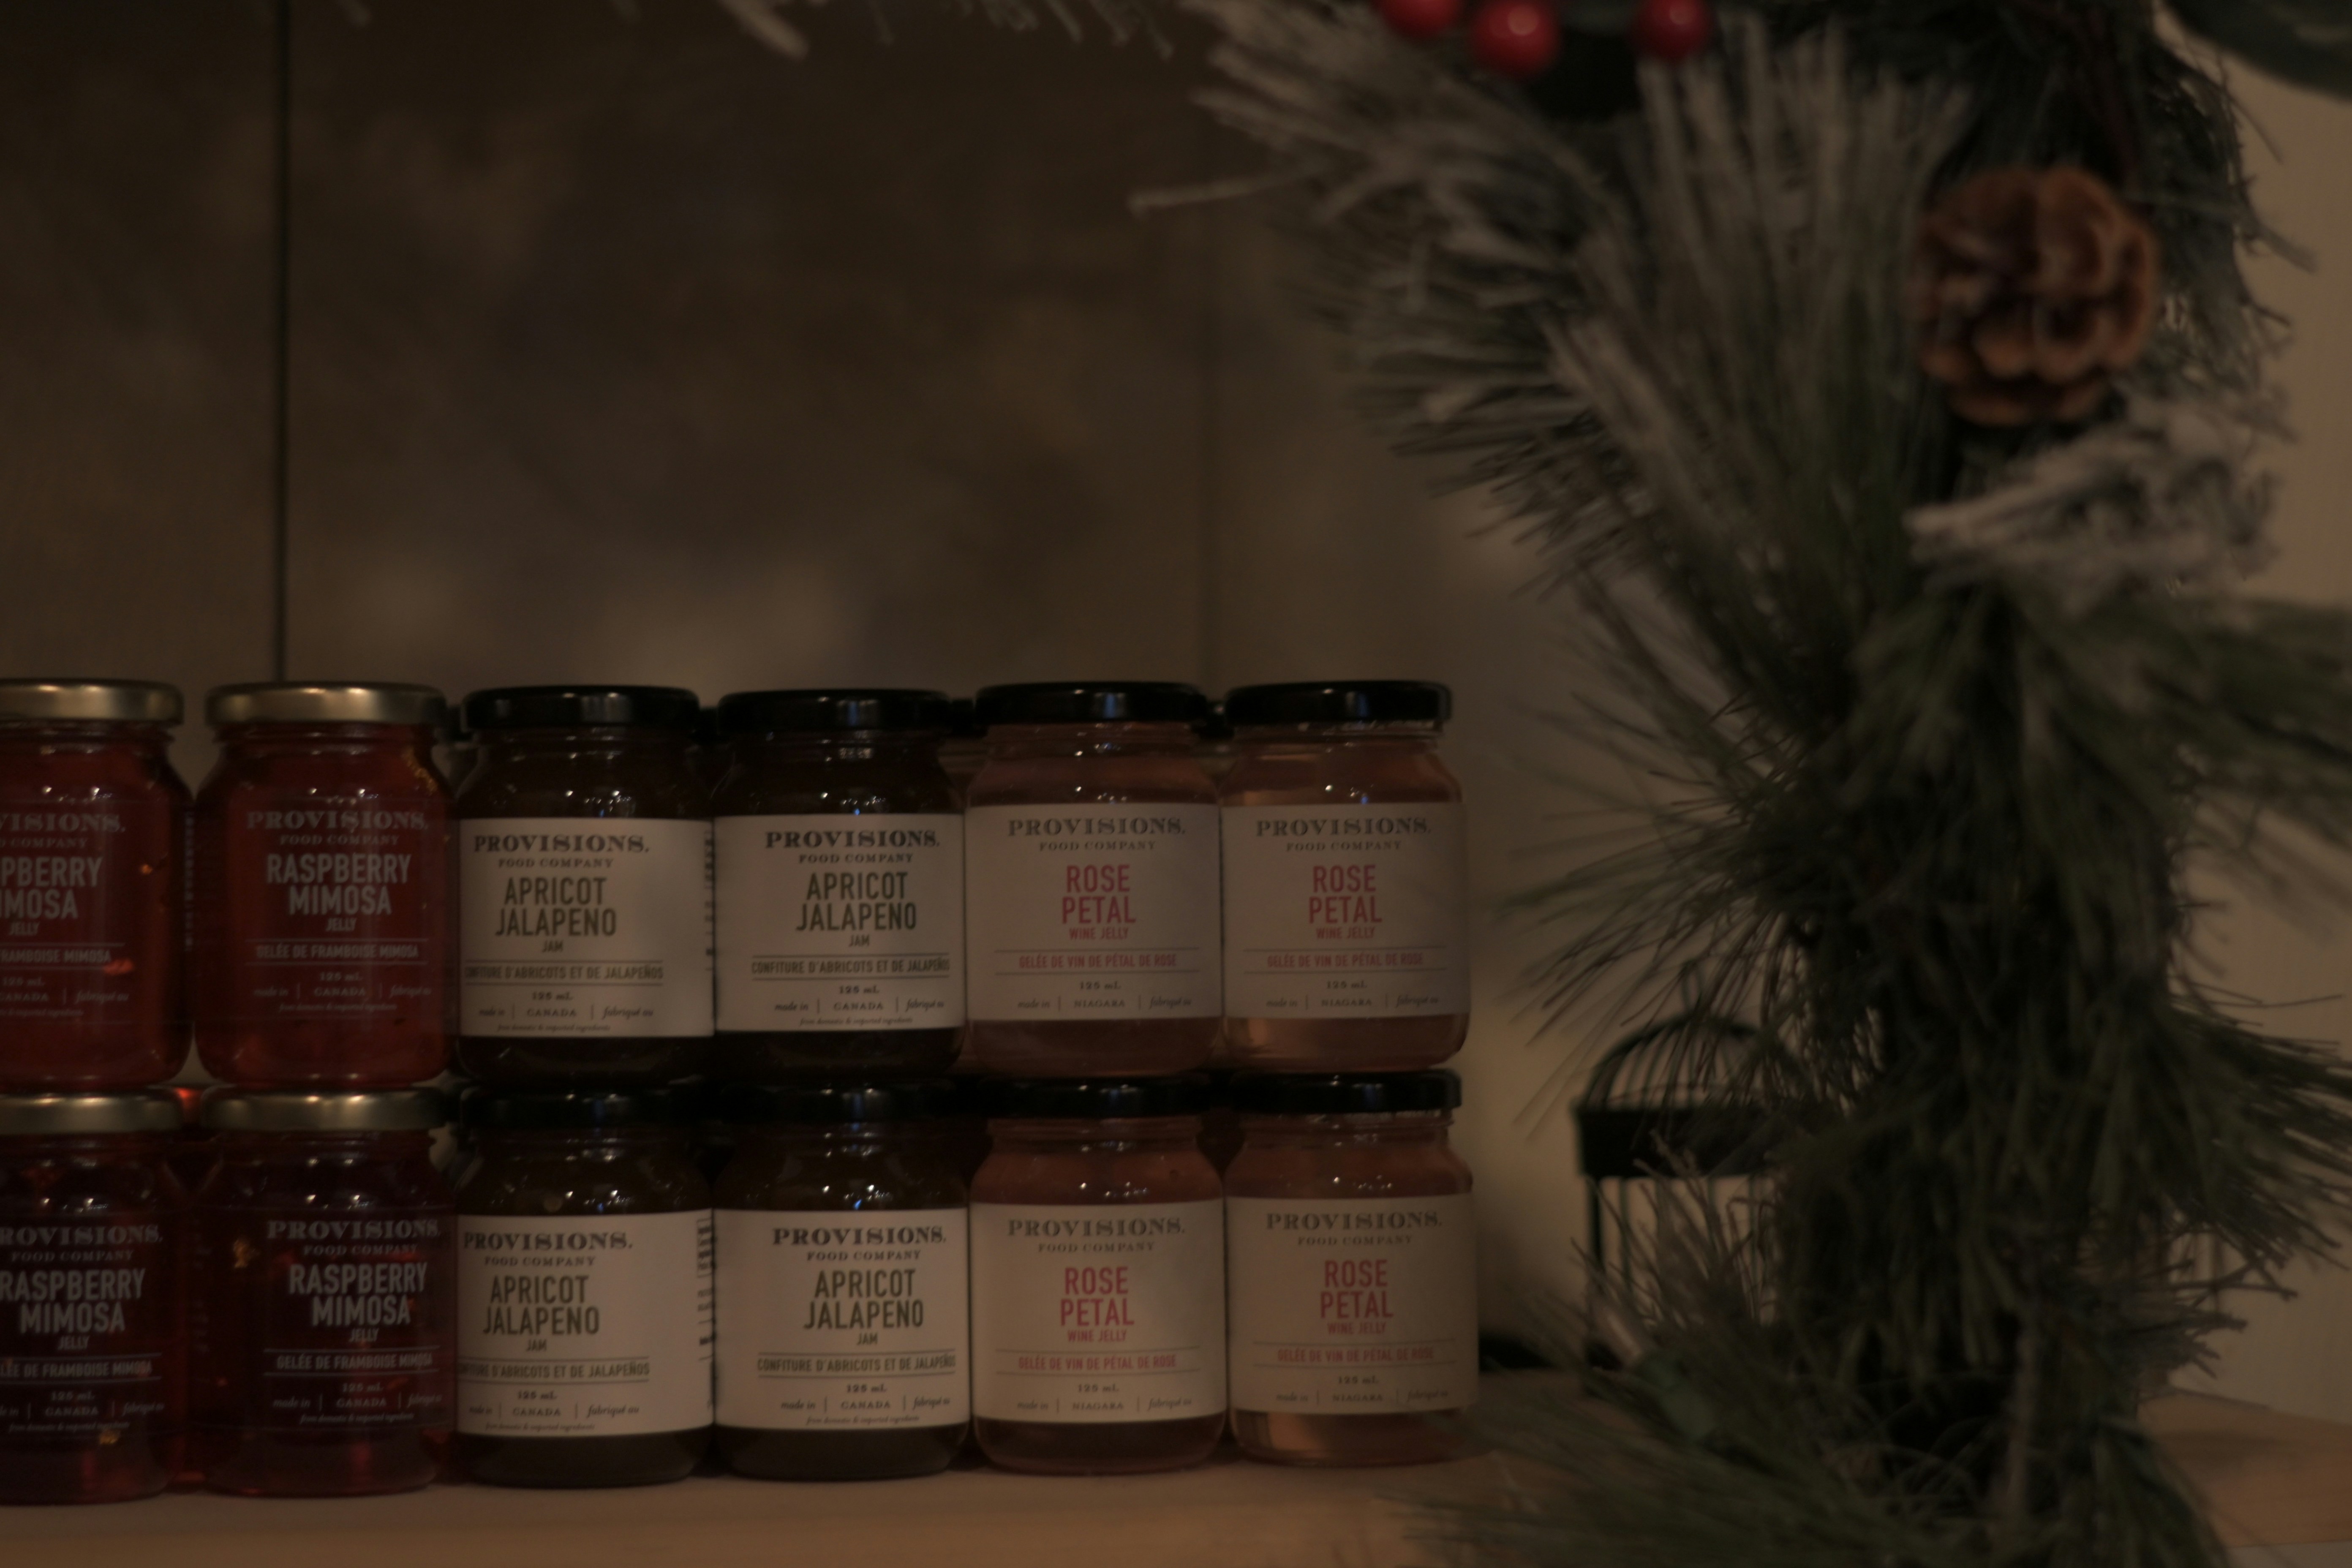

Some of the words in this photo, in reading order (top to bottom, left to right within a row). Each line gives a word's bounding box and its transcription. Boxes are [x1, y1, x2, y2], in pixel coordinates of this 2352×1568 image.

[280, 835, 322, 845] FOOD
[327, 834, 400, 845] COMPANY
[1040, 841, 1079, 852] FOOD
[1085, 841, 1155, 851] COMPANY
[1287, 842, 1325, 852] FOOD
[1330, 841, 1402, 850] COMPANY
[498, 859, 534, 868] FOOD
[540, 859, 613, 868] COMPANY
[799, 855, 839, 863] FOOD
[845, 854, 914, 863] COMPANY
[267, 853, 411, 884] RASPBERRY
[806, 872, 908, 900] APRICOT
[1066, 865, 1130, 893] ROSE
[1313, 865, 1376, 893] ROSE
[504, 877, 606, 905] APRICOT
[289, 885, 392, 915] MIMOSA
[796, 903, 917, 931] JALAPENO
[1062, 896, 1135, 924] PETAL
[1309, 896, 1382, 924] PETAL
[9, 922, 40, 936] JELLY
[326, 918, 357, 931] JELLY
[495, 909, 617, 936] JALAPENO
[1069, 928, 1096, 940] WINE
[1100, 928, 1128, 940] JELLY
[1316, 927, 1342, 939] WINE
[1347, 927, 1375, 938] JELLY
[542, 941, 563, 952] JAM
[849, 935, 870, 947] JAM
[293, 945, 308, 958] DE
[311, 945, 376, 958] FRAMBOISE
[752, 961, 804, 974] CONFITURE
[877, 960, 888, 972] ET
[892, 959, 904, 972] DE
[1019, 954, 1047, 968] GELÉE
[1051, 956, 1063, 968] DE
[1067, 956, 1085, 967] VIN
[1089, 955, 1102, 967] DE
[1105, 953, 1135, 967] PÉTAL
[1139, 955, 1151, 967] DE
[1154, 954, 1177, 966] ROSE
[1299, 955, 1310, 967] DE
[1315, 955, 1331, 966] VIN
[1335, 955, 1348, 966] DE
[1386, 953, 1397, 965] DE
[570, 967, 583, 978] ET
[587, 967, 601, 978] DE
[527, 1009, 577, 1017] CANADA
[833, 1002, 883, 1010] CANADA
[1038, 1244, 1078, 1253] FOOD
[1083, 1241, 1155, 1252] COMPANY
[1298, 1236, 1337, 1245] FOOD
[1342, 1235, 1413, 1245] COMPANY
[11, 1252, 54, 1262] FOOD
[60, 1250, 135, 1262] COMPANY
[303, 1245, 347, 1255] FOOD
[351, 1244, 418, 1255] COMPANY
[807, 1252, 847, 1261] FOOD
[853, 1250, 920, 1260] COMPANY
[485, 1257, 517, 1266] FOOD
[523, 1257, 596, 1266] COMPANY
[289, 1262, 427, 1294] RASPBERRY
[1064, 1267, 1129, 1295] ROSE
[1325, 1260, 1388, 1288] ROSE
[0, 1268, 147, 1301] RASPBERRY
[490, 1275, 589, 1304] APRICOT
[815, 1269, 915, 1298] APRICOT
[312, 1295, 411, 1326] MIMOSA
[1060, 1298, 1135, 1326] PETAL
[1320, 1291, 1393, 1319] PETAL
[19, 1301, 125, 1334] MIMOSA
[483, 1306, 599, 1335] JALAPENO
[804, 1299, 923, 1329] JALAPENO
[349, 1328, 379, 1342] JELLY
[1327, 1322, 1353, 1334] WINE
[1358, 1322, 1386, 1334] JELLY
[857, 1333, 877, 1345] JAM
[1067, 1330, 1094, 1342] WINE
[1098, 1329, 1127, 1342] JELLY
[57, 1336, 90, 1350] JELLY
[527, 1339, 547, 1351] JAM
[277, 1353, 312, 1369] GELÉE
[316, 1356, 330, 1369] DE
[334, 1355, 396, 1369] FRAMBOISE
[1019, 1355, 1046, 1369] GELÉE
[1050, 1357, 1061, 1369] DE
[1066, 1357, 1083, 1369] VIN
[1087, 1357, 1099, 1369] DE
[1104, 1354, 1134, 1369] PÉTAL
[1137, 1356, 1150, 1368] DE
[1153, 1354, 1176, 1367] ROSE
[1309, 1350, 1322, 1362] DE
[1326, 1350, 1343, 1361] VIN
[1347, 1349, 1359, 1361] DE
[1396, 1348, 1408, 1360] DE
[24, 1364, 38, 1377] DE
[43, 1363, 109, 1377] FRAMBOISE
[554, 1365, 566, 1378] ET
[570, 1365, 584, 1377] DE
[758, 1358, 811, 1371] CONFITURE
[885, 1359, 895, 1370] ET
[899, 1358, 911, 1370] DE
[847, 1384, 866, 1392] 125
[513, 1407, 561, 1416] CANADA
[841, 1401, 890, 1410] CANADA
